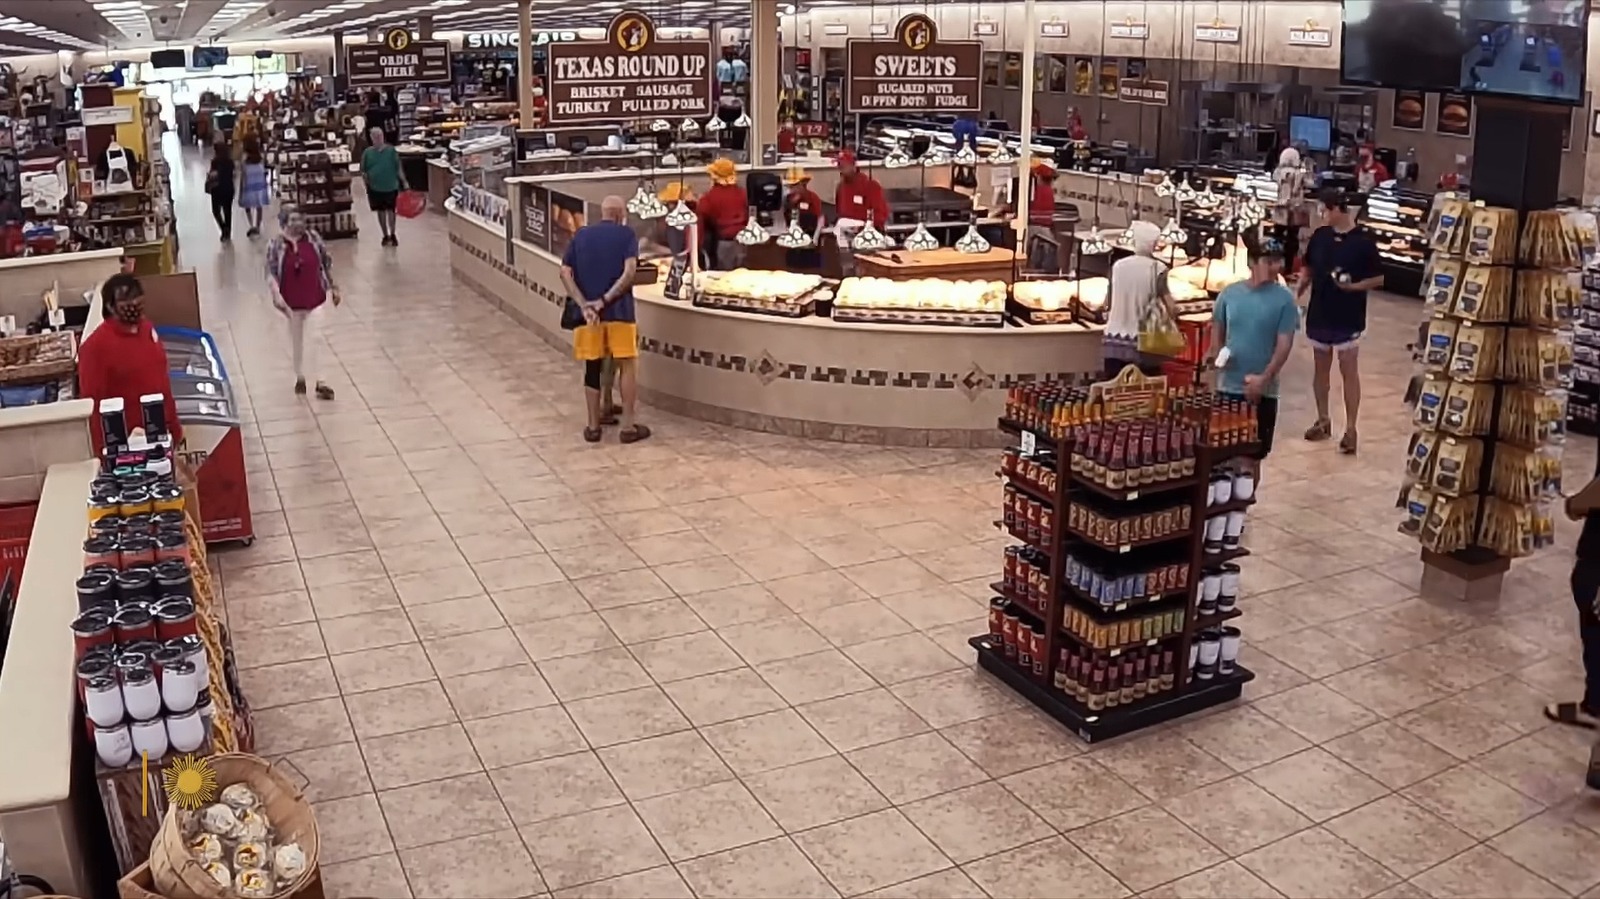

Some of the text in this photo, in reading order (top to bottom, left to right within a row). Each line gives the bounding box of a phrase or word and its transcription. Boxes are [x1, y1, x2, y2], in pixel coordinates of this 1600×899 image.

[379, 53, 419, 66] ORDER
[874, 55, 957, 76] SWEETS
[384, 66, 416, 77] HERE
[555, 55, 706, 79] TEXAS ROUND UP
[570, 84, 693, 99] BRISKET SAUSAGE
[877, 83, 953, 94] SUGARED NUTS
[556, 98, 705, 114] TURKEY PULLED PORK
[900, 95, 928, 107] DOTS
[935, 95, 968, 106] FUDGE
